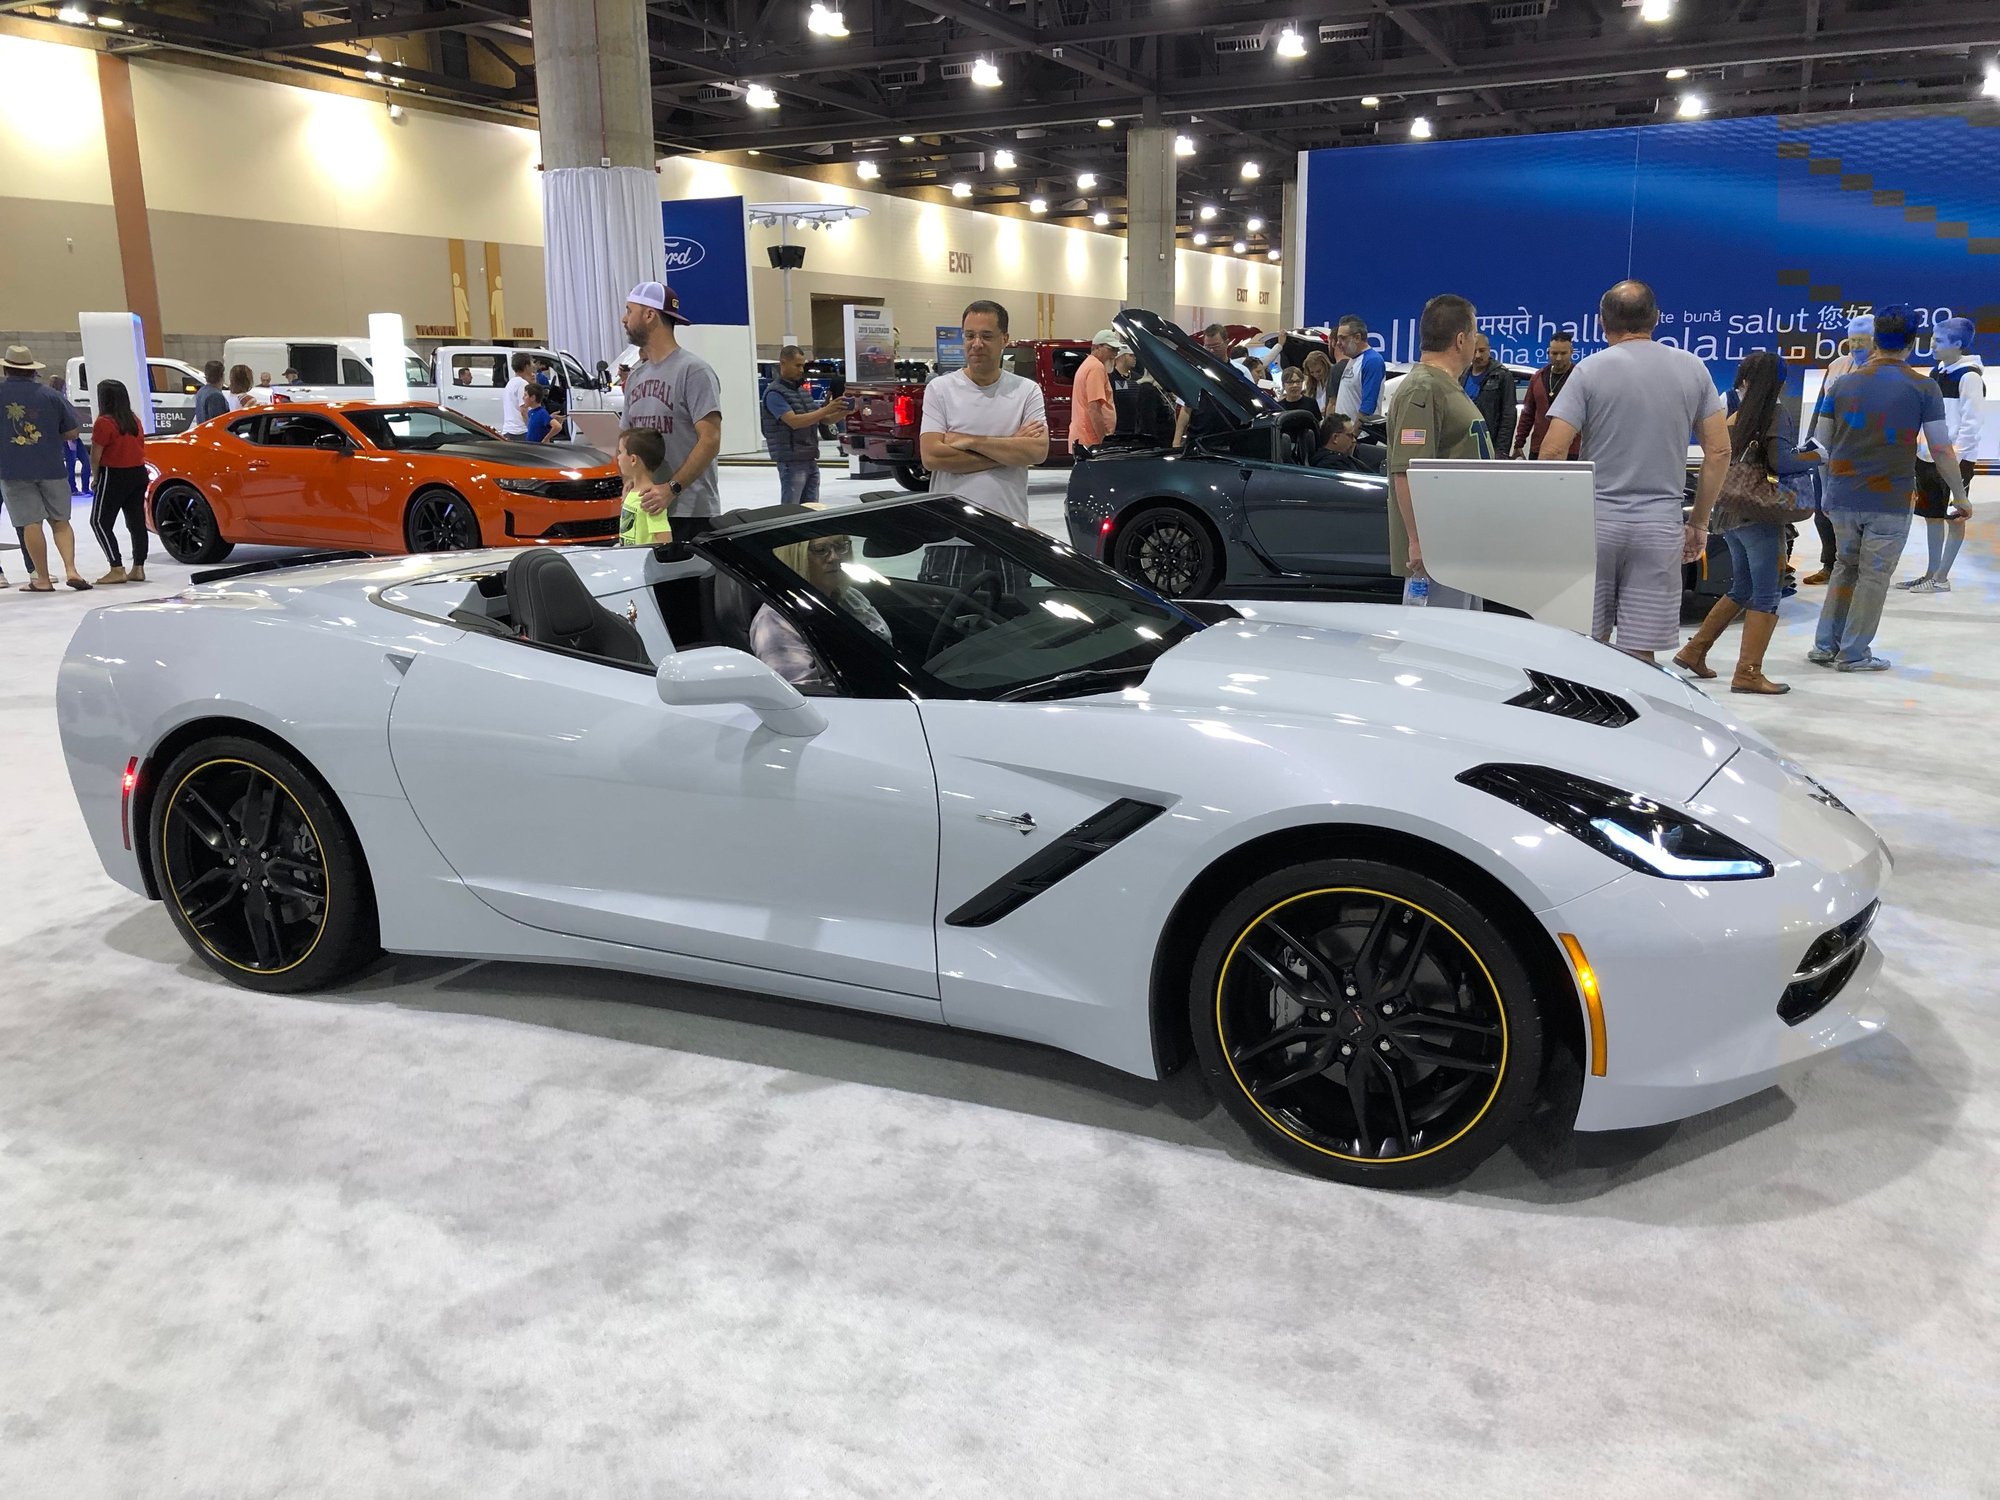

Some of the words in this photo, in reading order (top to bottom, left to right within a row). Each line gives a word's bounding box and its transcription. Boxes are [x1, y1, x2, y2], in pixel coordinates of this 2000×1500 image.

[948, 251, 972, 274] EXIT
[1236, 288, 1248, 302] EXIT
[1259, 291, 1270, 305] EXIT
[1683, 309, 1722, 323] bună
[1728, 307, 1809, 335] salut
[415, 325, 458, 336] WOMEN
[1476, 306, 1533, 343] मस्ते
[1537, 314, 1608, 343] hall
[512, 327, 534, 338] MEN
[1655, 327, 1719, 361] ola
[155, 412, 186, 421] ERCIAL
